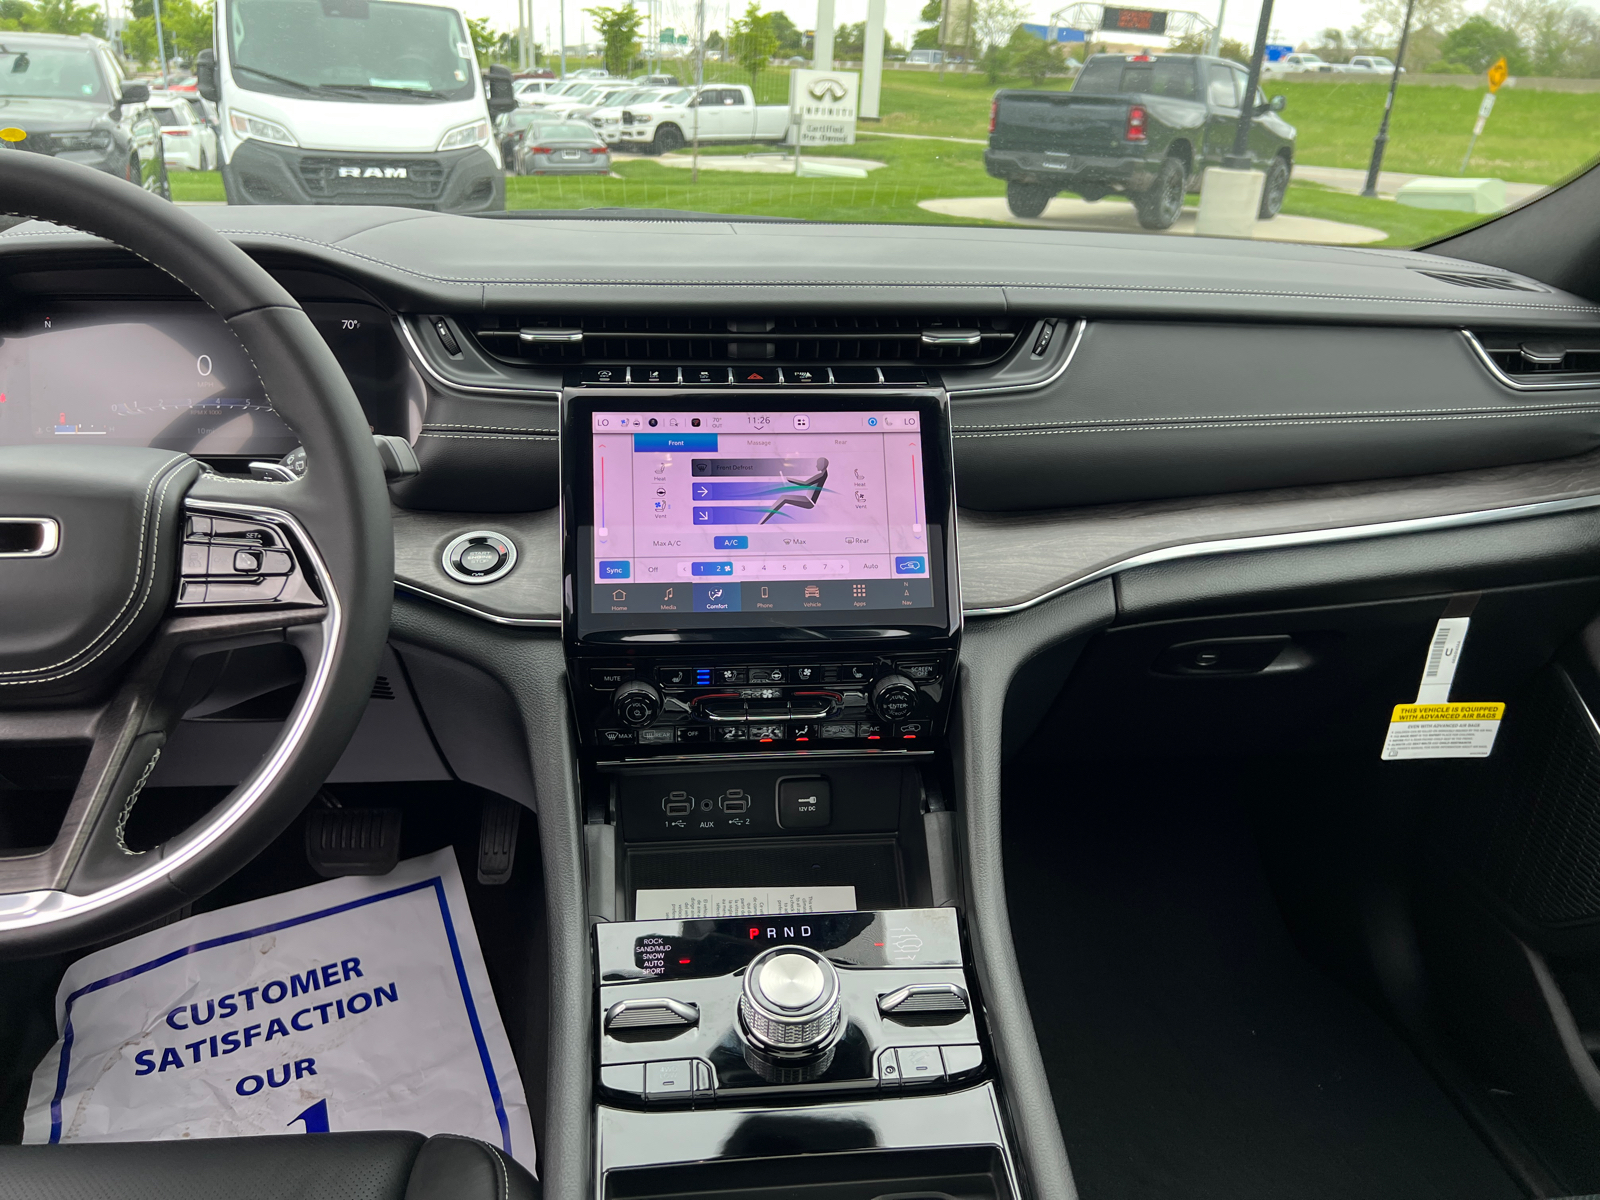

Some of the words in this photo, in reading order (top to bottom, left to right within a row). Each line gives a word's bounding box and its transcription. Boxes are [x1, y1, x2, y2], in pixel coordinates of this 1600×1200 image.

[338, 166, 407, 178] RAM
[196, 354, 212, 376] 0
[597, 418, 610, 427] LO
[747, 416, 771, 425] 11:26
[904, 418, 916, 426] LO
[750, 928, 760, 940] P
[767, 928, 777, 938] R
[784, 926, 794, 938] N
[801, 926, 811, 936] D
[166, 956, 364, 1030] CUSTOMER
[134, 982, 399, 1076] SATISFACTION
[236, 1058, 318, 1096] OUR
